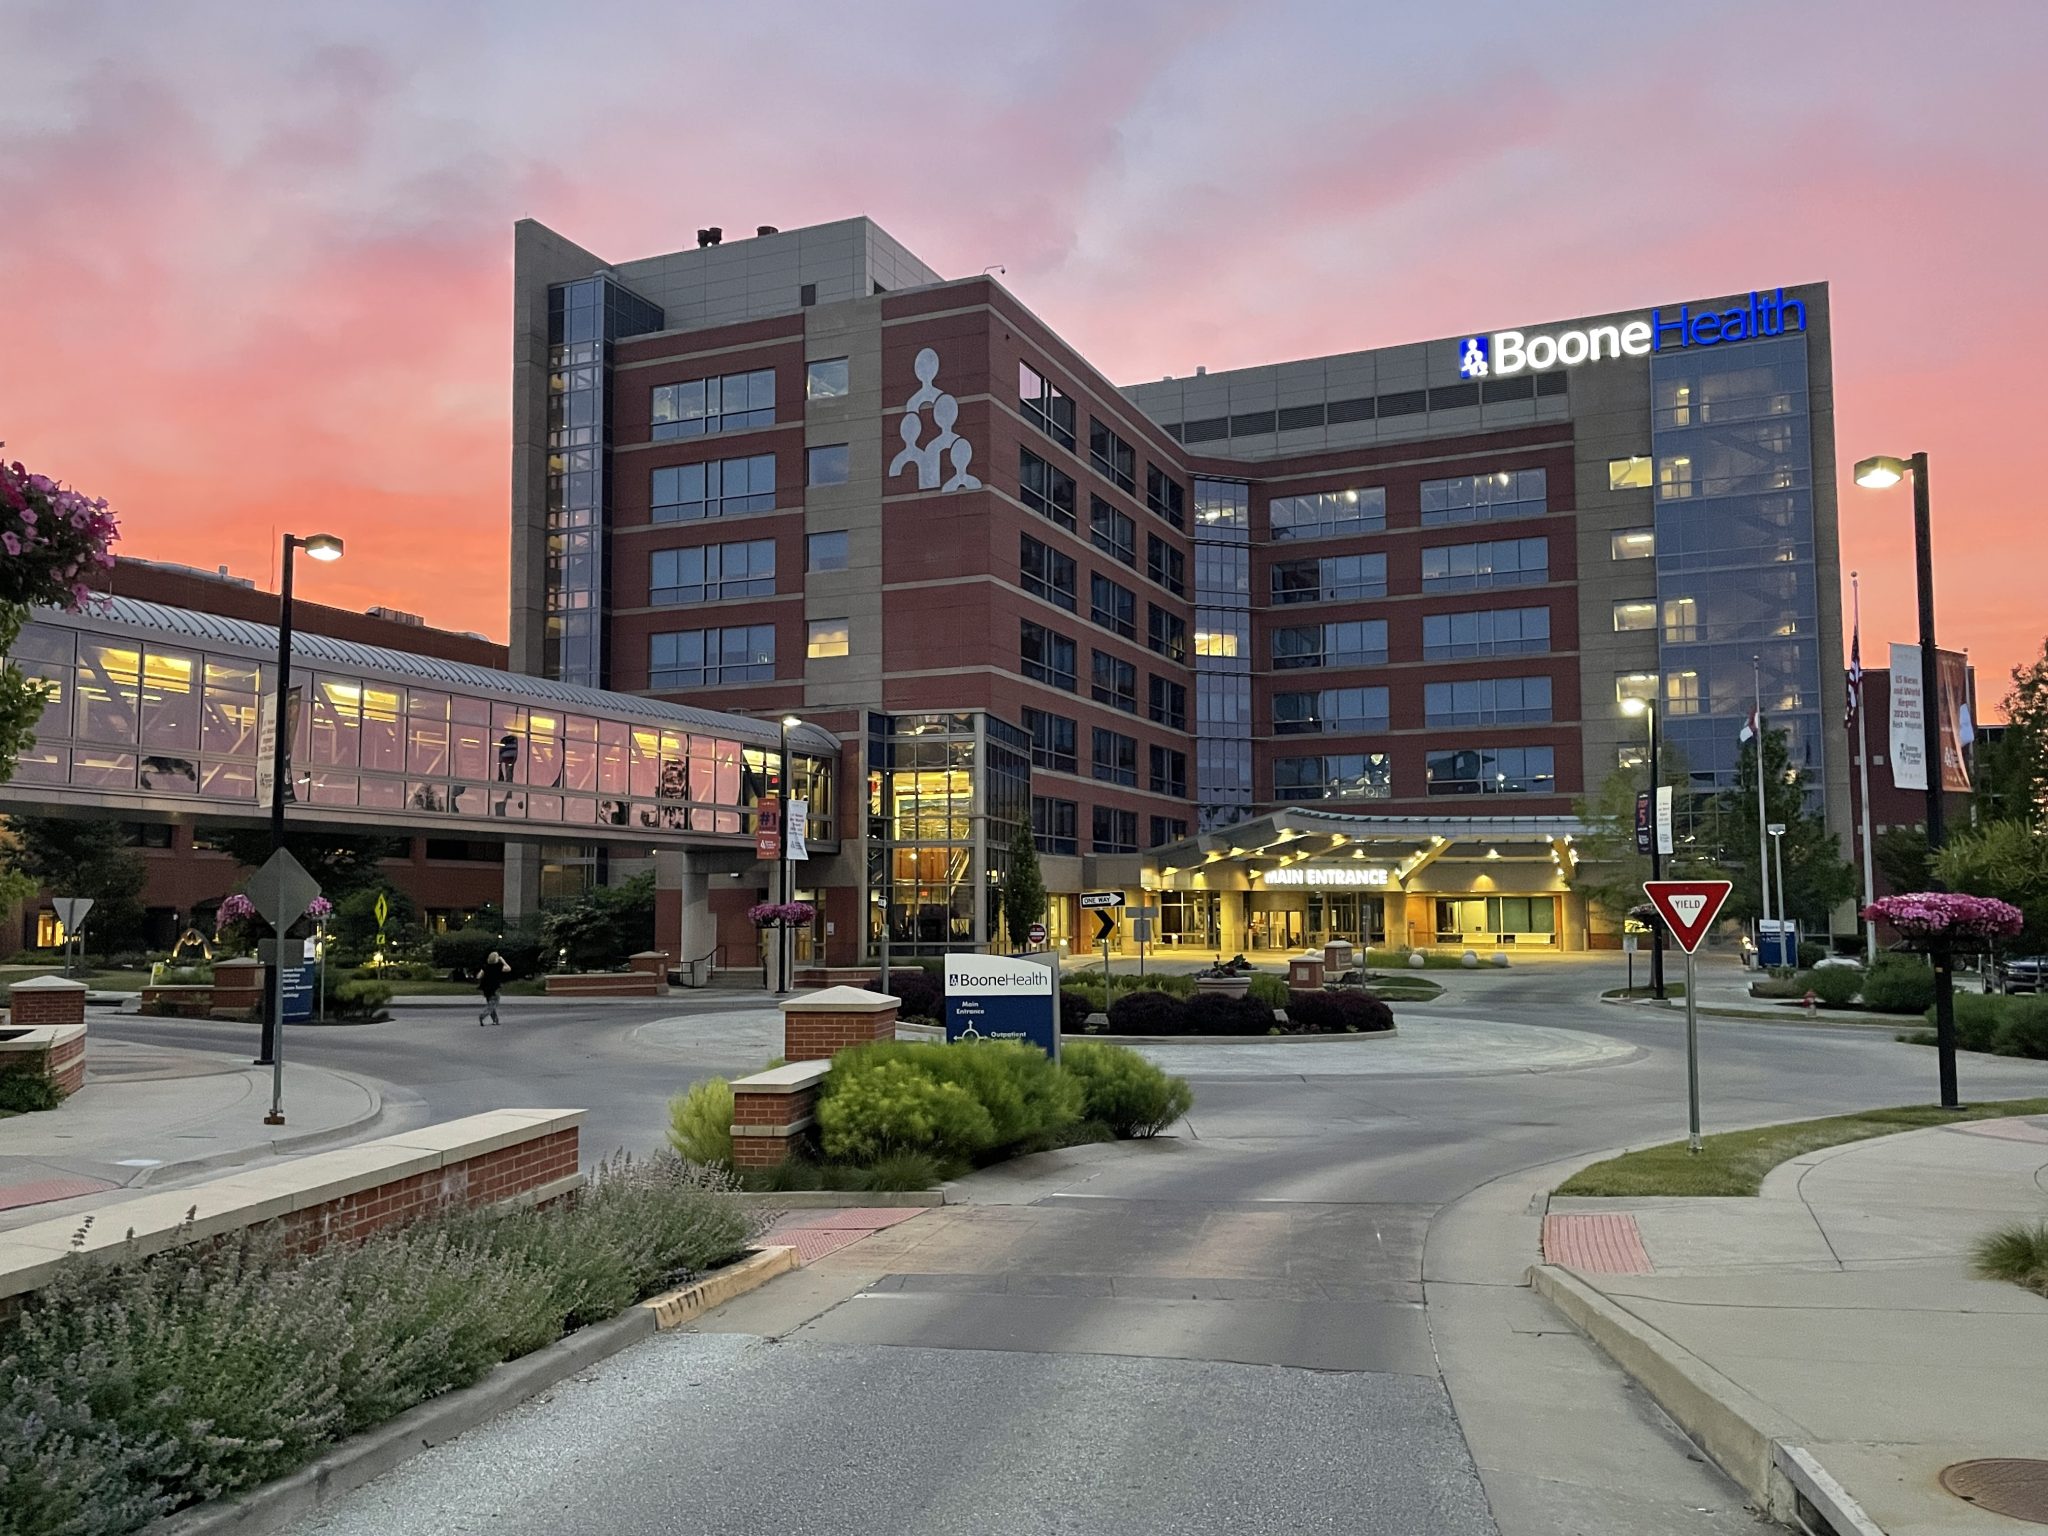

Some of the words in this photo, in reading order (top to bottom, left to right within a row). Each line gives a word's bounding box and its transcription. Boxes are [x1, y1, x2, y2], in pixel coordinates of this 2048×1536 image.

[1493, 287, 1806, 376] BooneHealth
[1264, 868, 1304, 884] MAIN
[1306, 868, 1388, 885] ENTRANCE
[1674, 900, 1701, 909] YIELD
[960, 971, 1048, 987] BooneHealth
[990, 1031, 1027, 1039] Outpatient
